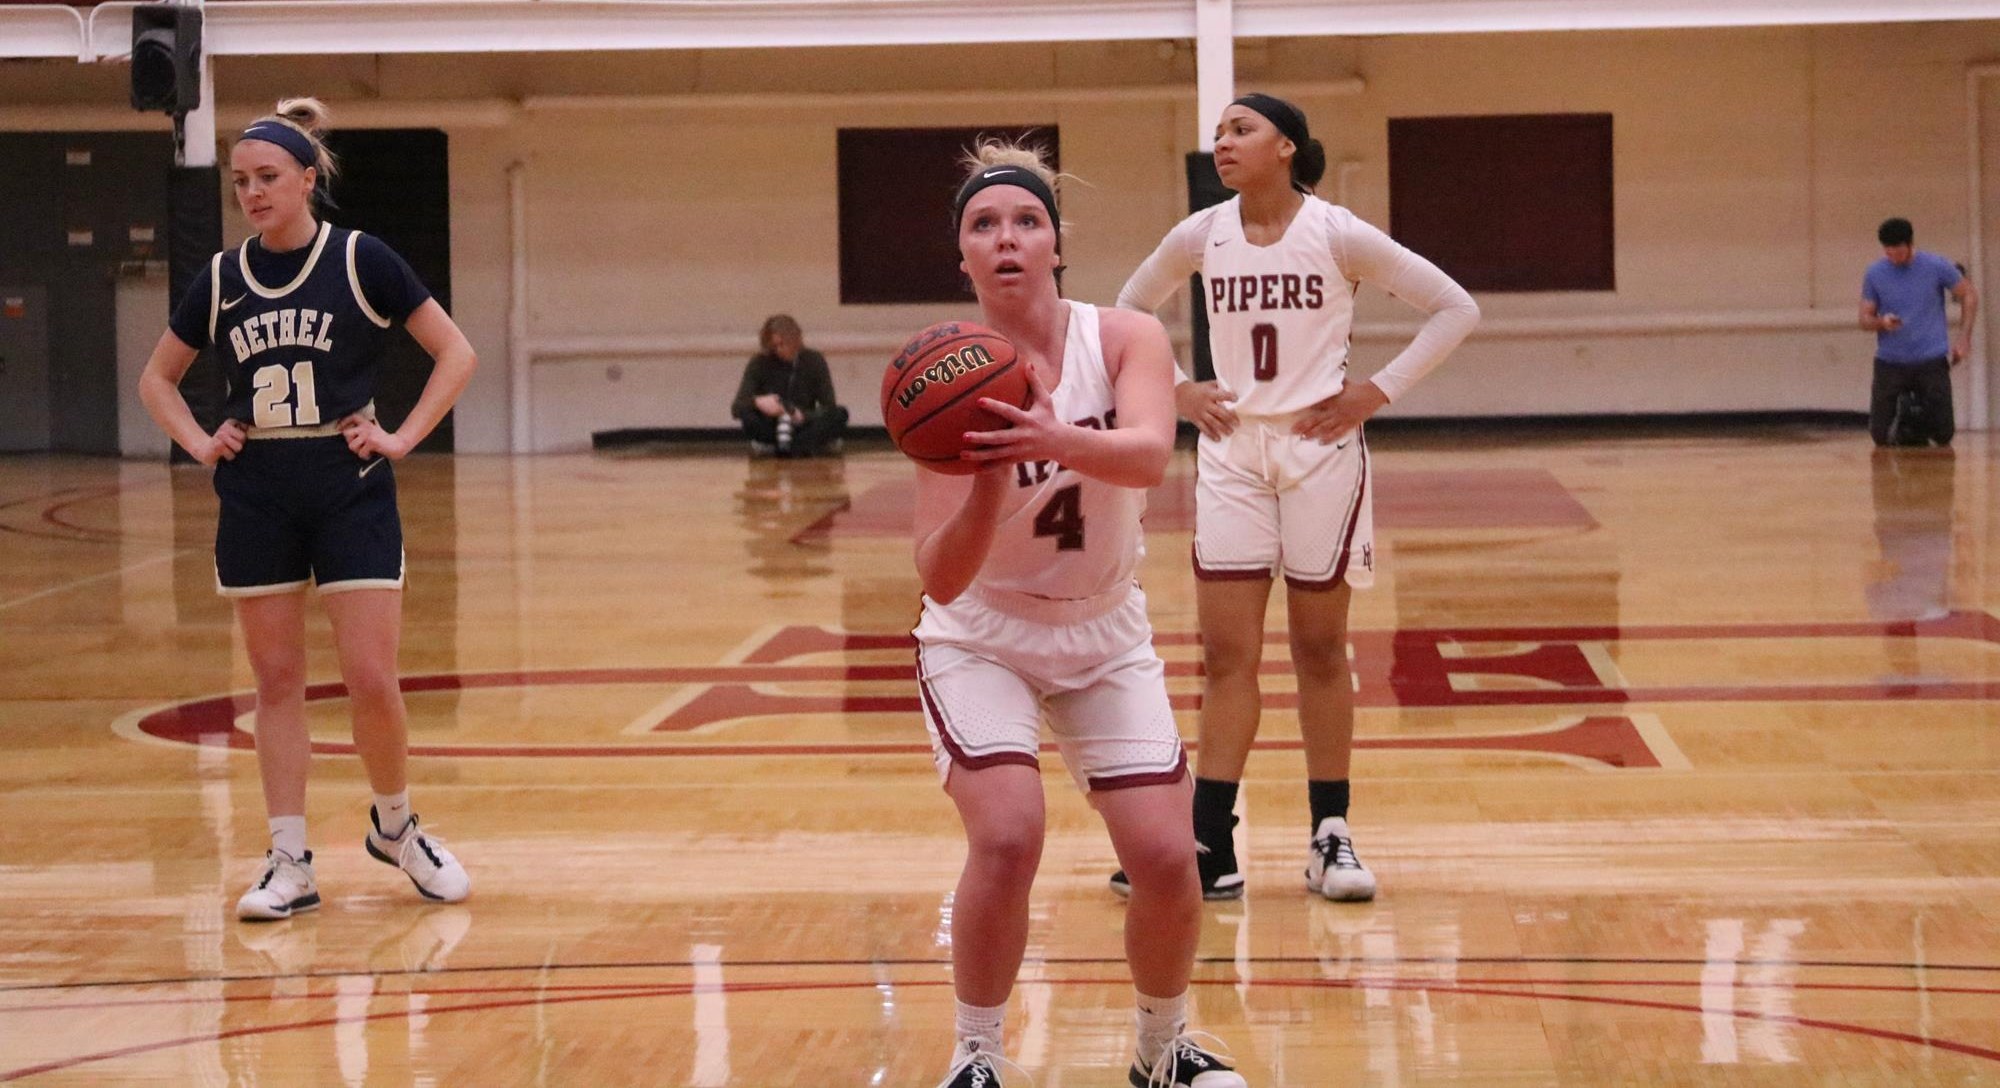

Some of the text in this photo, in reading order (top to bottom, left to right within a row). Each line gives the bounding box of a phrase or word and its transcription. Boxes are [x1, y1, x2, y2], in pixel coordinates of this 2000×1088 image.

[1210, 274, 1323, 314] PIPERS
[229, 308, 334, 363] BETHEL
[1251, 322, 1278, 382] 0
[252, 361, 320, 428] 21
[897, 342, 996, 409] Wilson
[1033, 481, 1086, 552] 4
